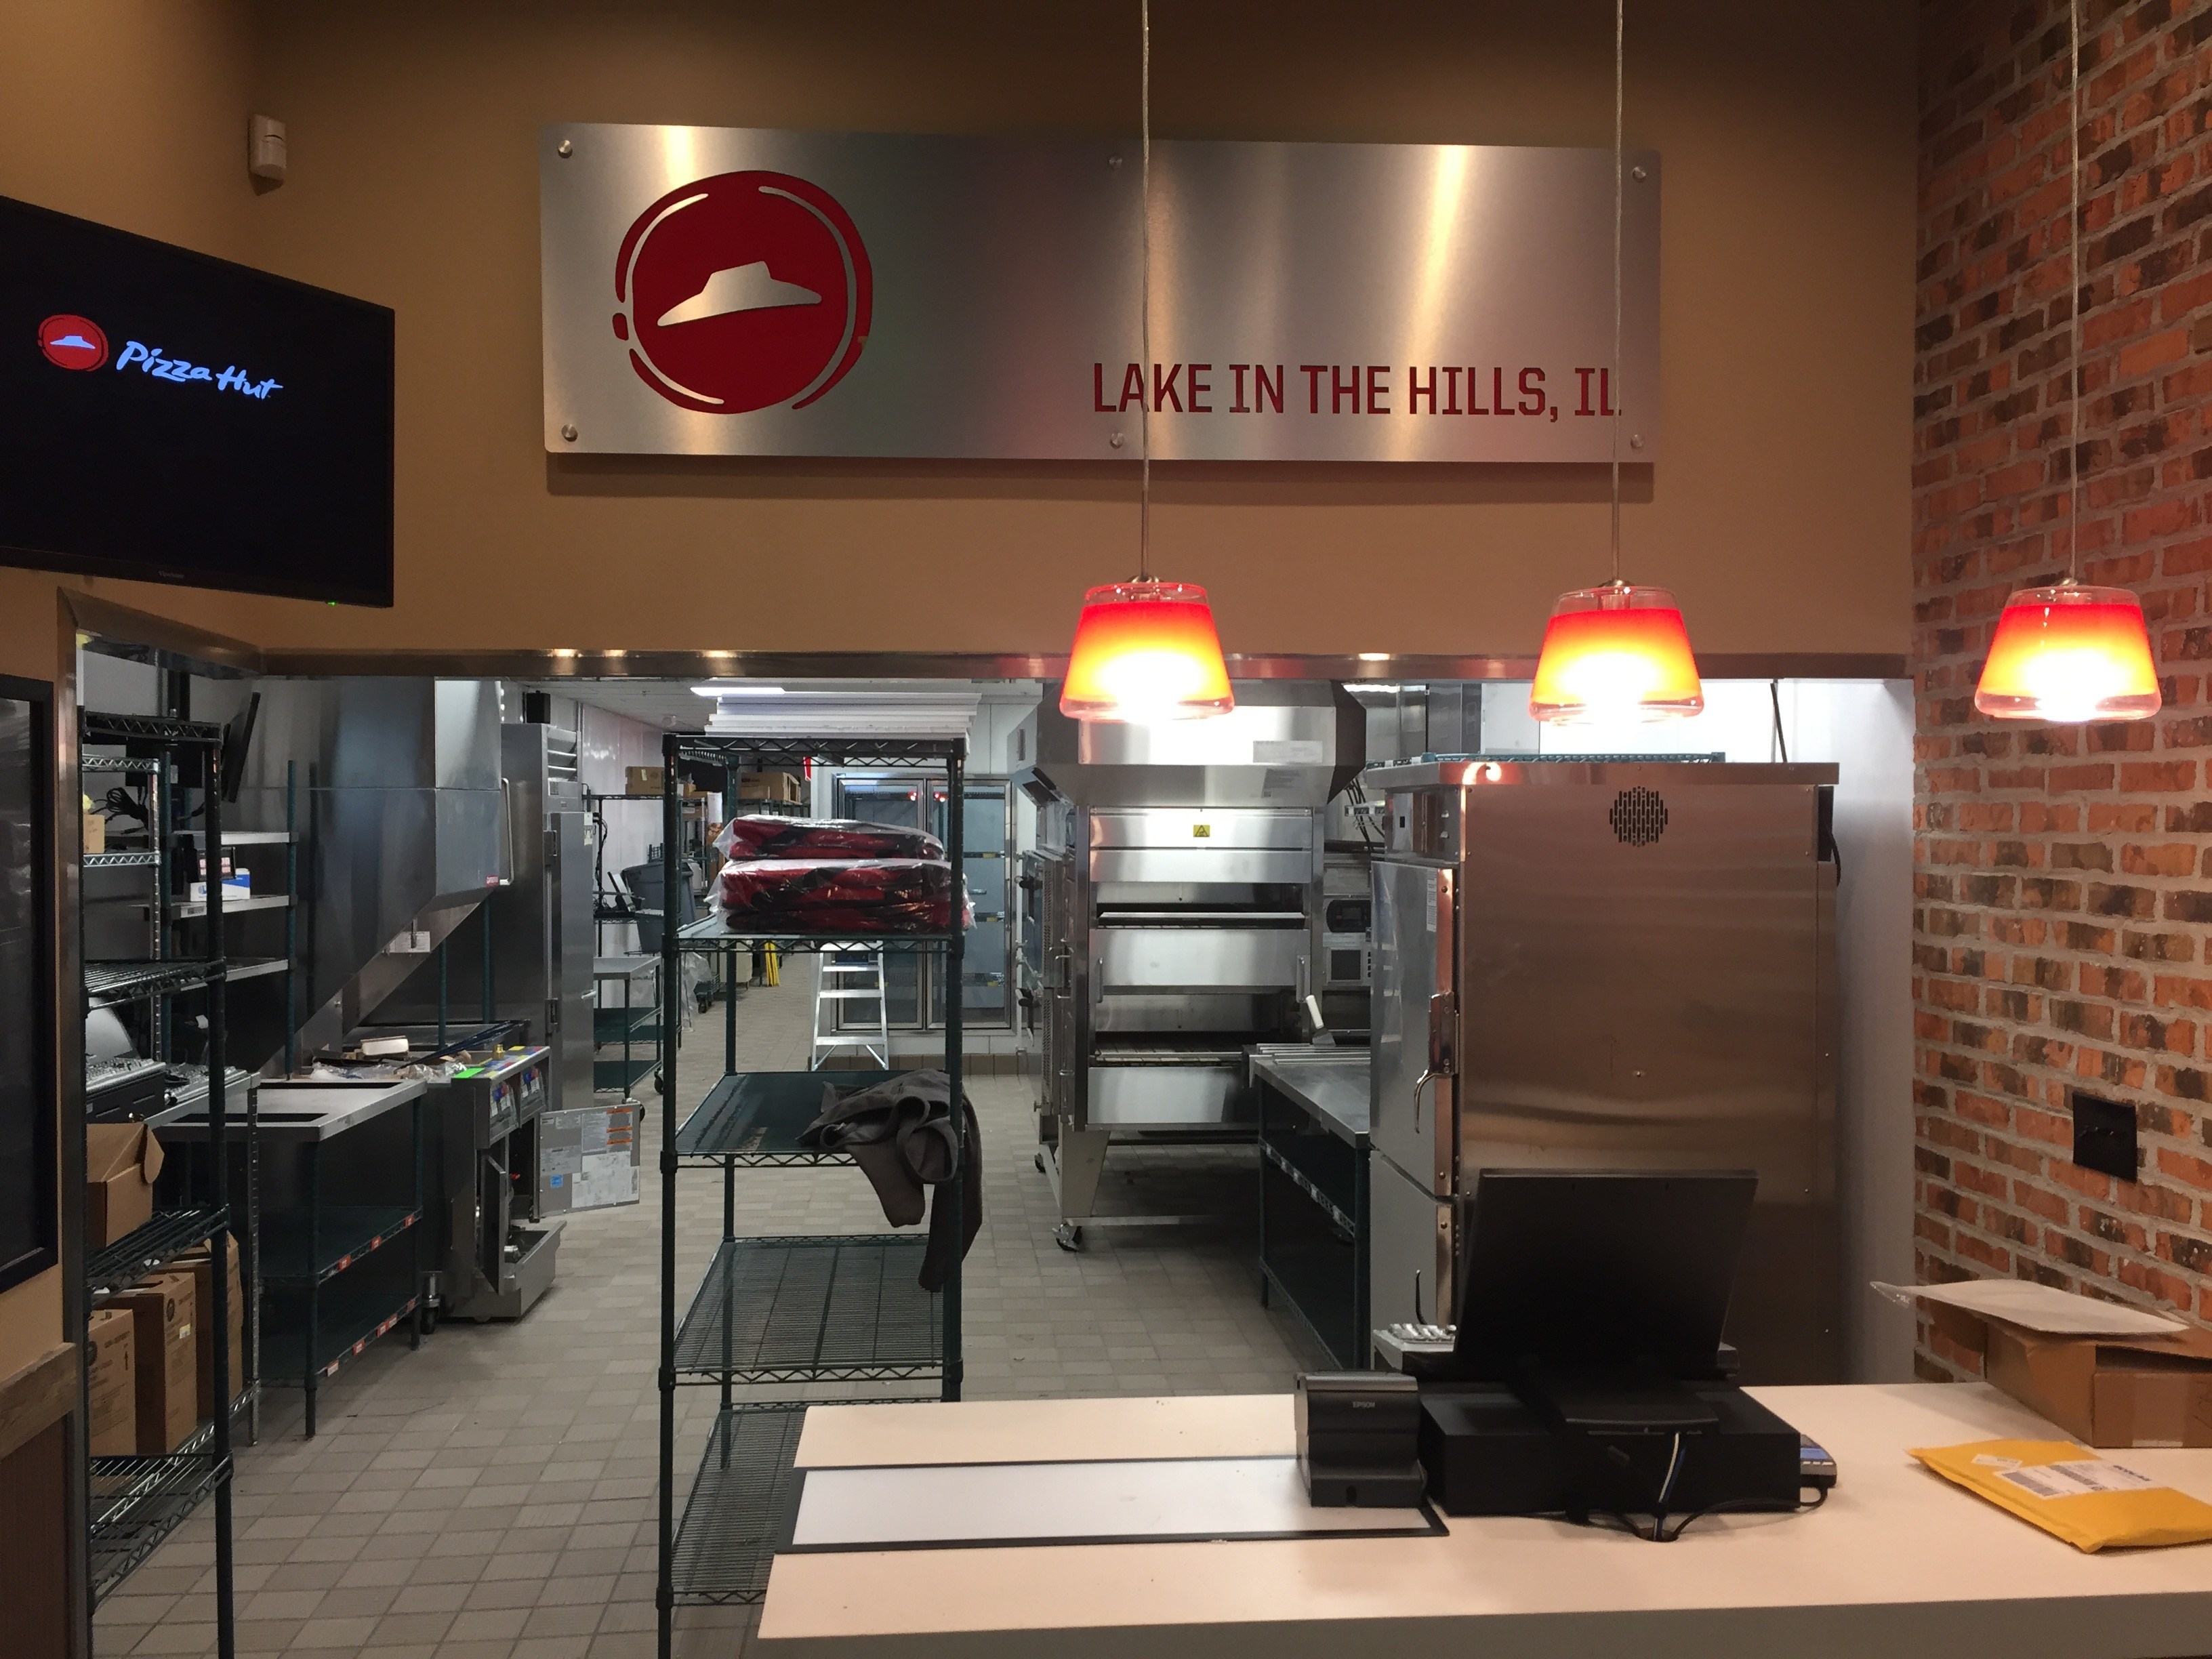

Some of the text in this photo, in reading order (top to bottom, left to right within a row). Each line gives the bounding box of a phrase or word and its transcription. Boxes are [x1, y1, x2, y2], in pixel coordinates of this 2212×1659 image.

[116, 340, 284, 399] Pizza Hut
[1094, 363, 1622, 423] LAKE IN THE HILLS, IL
[1352, 1401, 1376, 1409] EPSON
